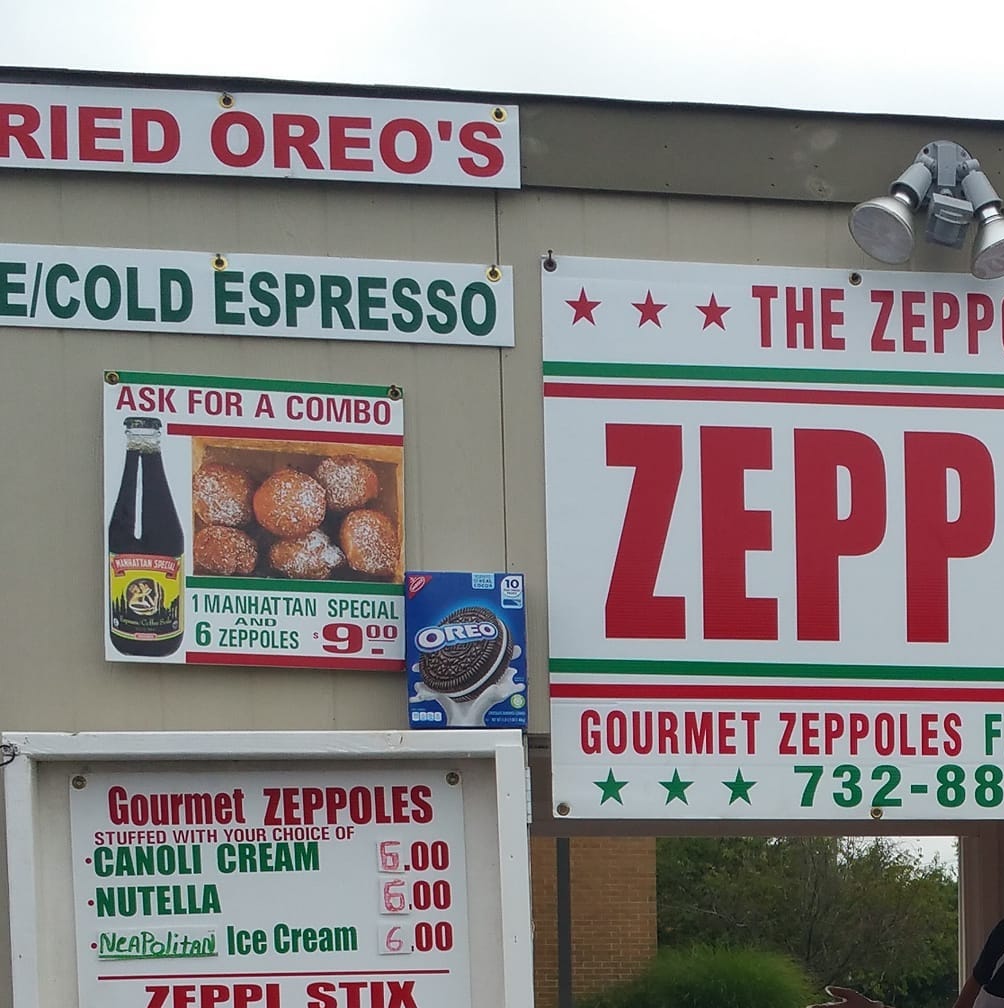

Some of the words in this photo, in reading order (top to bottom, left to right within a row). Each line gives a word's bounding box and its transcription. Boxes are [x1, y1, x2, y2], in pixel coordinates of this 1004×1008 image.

[210, 111, 505, 178] OREO'S
[214, 270, 497, 337] ESPRESSO
[752, 285, 846, 350] THE
[116, 385, 177, 414] ASK
[188, 389, 243, 417] FOR
[254, 393, 275, 420] A
[287, 394, 392, 426] COMBO
[116, 558, 152, 569] MANHATTAN
[505, 579, 519, 588] 10
[192, 594, 199, 613] 1
[204, 594, 317, 616] MANHATTAN
[328, 598, 399, 619] SPECIAL
[234, 617, 277, 627] AND
[195, 621, 212, 646] 6
[219, 628, 299, 649] ZEPPOLES
[417, 622, 496, 650] OREO
[580, 708, 761, 756] GOURMET
[778, 710, 963, 758] ZEPPOLES
[108, 785, 245, 826] Gourmet
[263, 784, 434, 826] ZEPPOLES
[94, 830, 167, 846] STUFFED
[173, 829, 218, 844] WITH
[223, 827, 267, 843] YOUR
[272, 826, 330, 842] CHOICE
[335, 825, 355, 840] OF
[93, 843, 201, 878] CANOLI
[217, 841, 320, 874] CREAM
[96, 884, 222, 917] NUTELLA
[227, 925, 268, 955] Ice
[274, 923, 358, 954] Cream
[385, 921, 453, 953] 6.00
